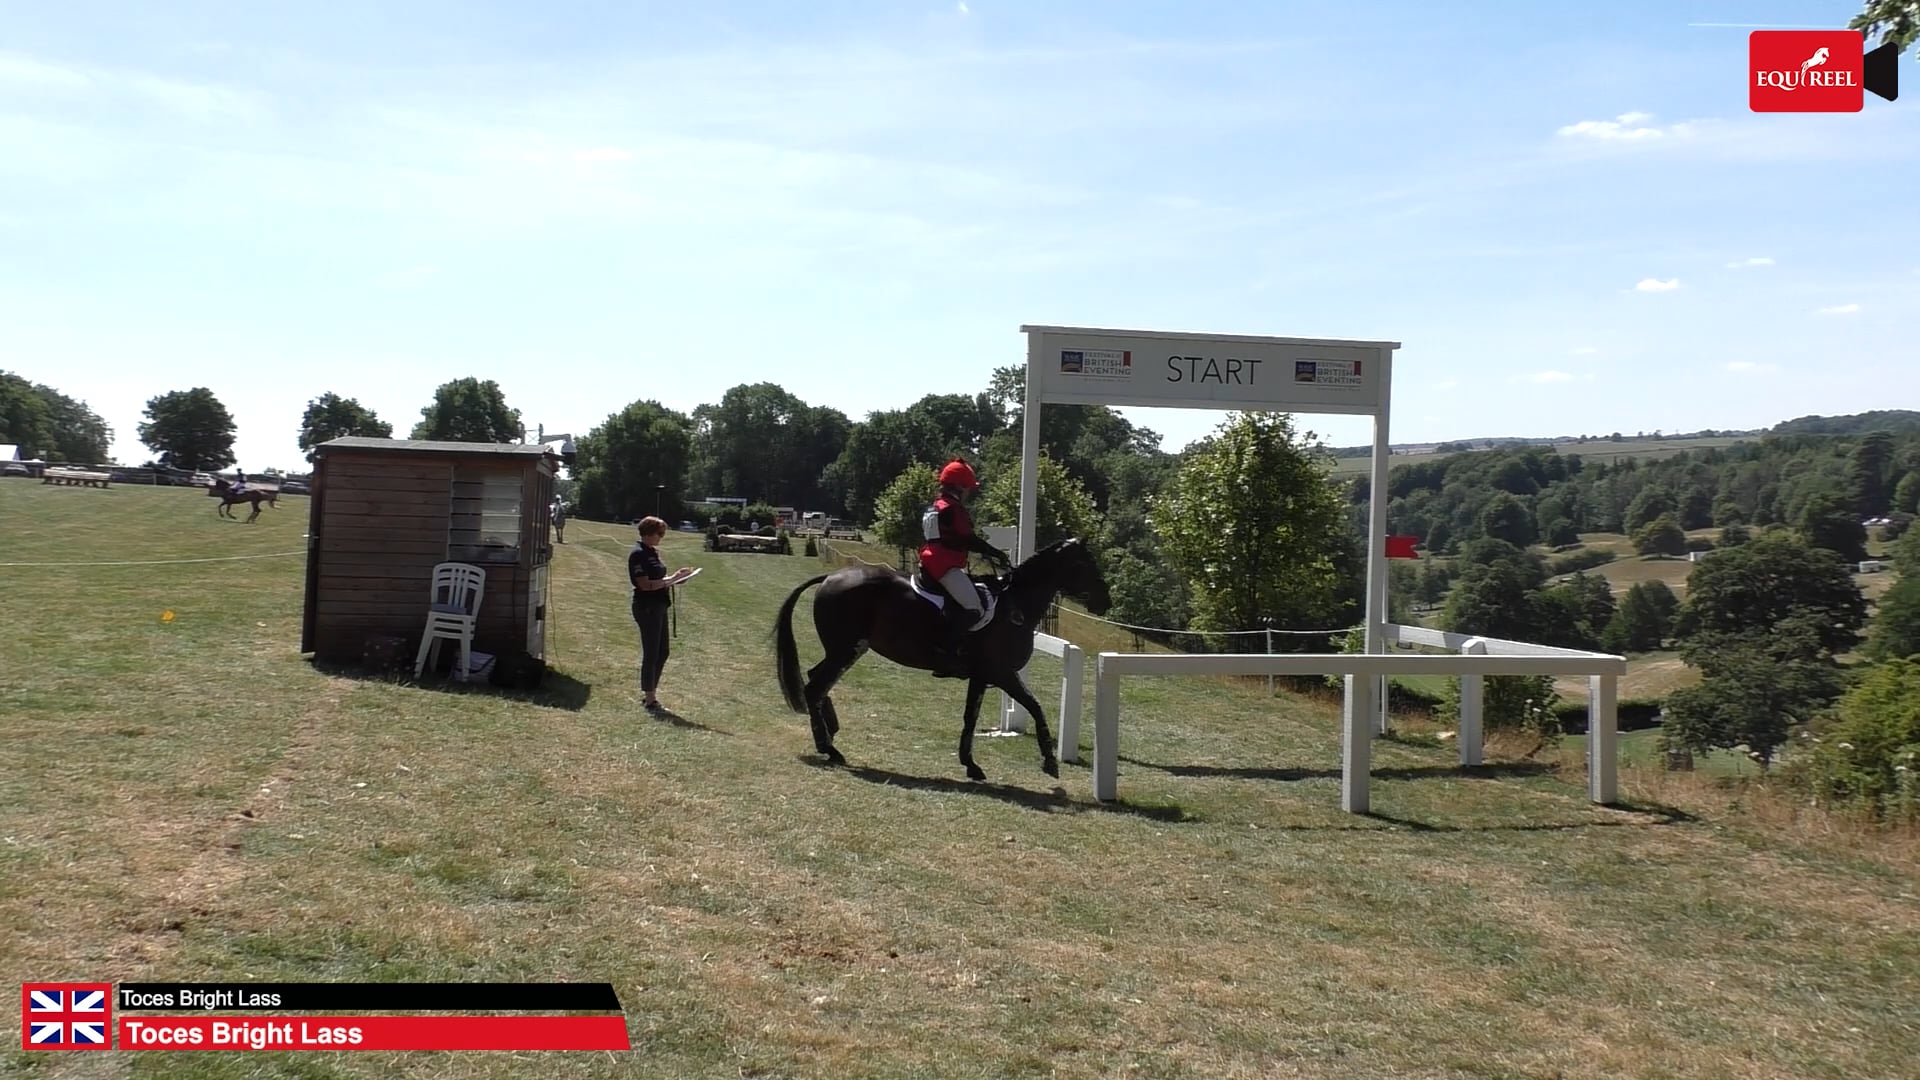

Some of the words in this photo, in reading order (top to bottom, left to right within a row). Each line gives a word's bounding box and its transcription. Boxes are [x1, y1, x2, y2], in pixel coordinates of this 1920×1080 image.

[1084, 358, 1121, 367] BRITISH
[1084, 367, 1131, 375] EVENTING
[1167, 355, 1262, 385] START
[1317, 367, 1353, 376] BRITISH
